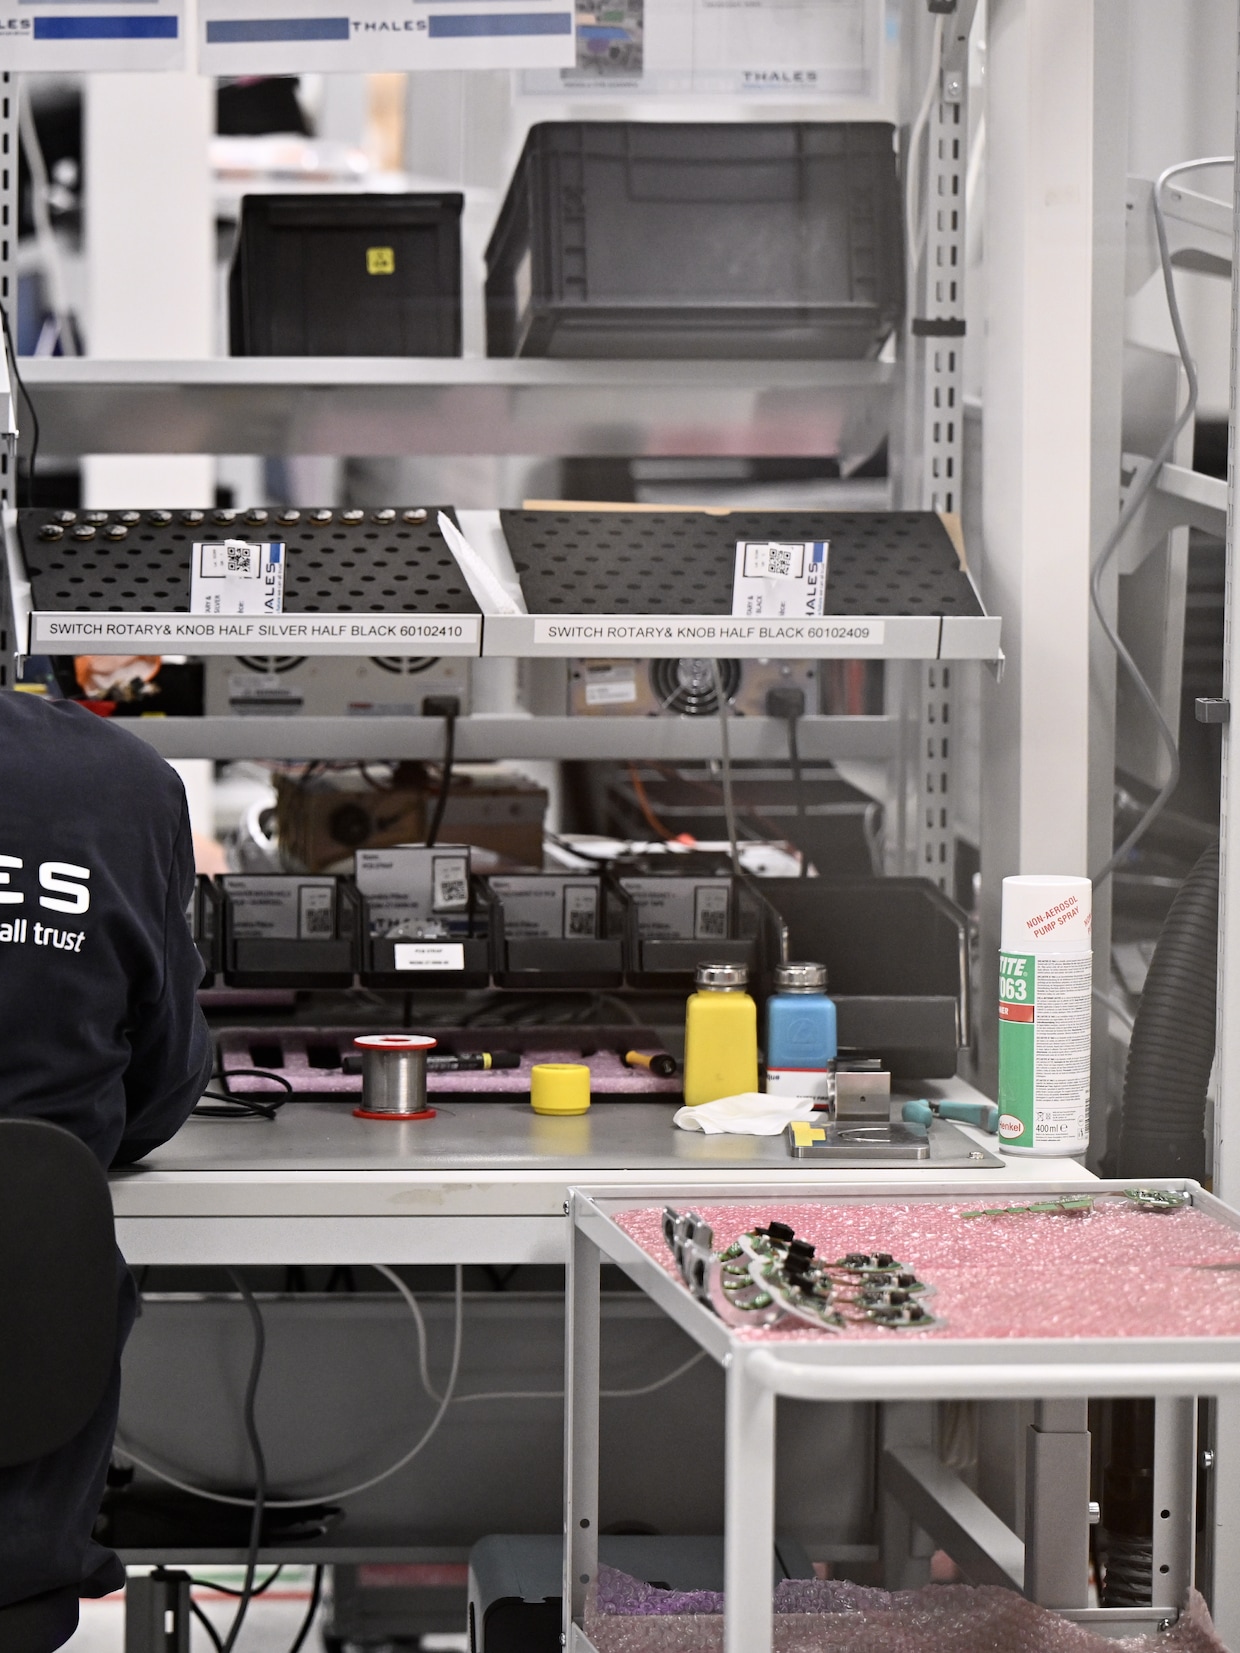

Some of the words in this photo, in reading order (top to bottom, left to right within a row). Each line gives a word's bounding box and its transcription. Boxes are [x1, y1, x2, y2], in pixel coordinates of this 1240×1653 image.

[352, 20, 426, 32] THALES
[742, 70, 818, 82] THALES
[50, 623, 102, 635] SWITCH
[106, 624, 172, 635] ROTARY&
[176, 625, 214, 635] KNOB
[219, 625, 254, 636] HALF
[258, 625, 307, 636] SILVER
[312, 626, 347, 636] HALF
[351, 626, 397, 636] BLACK
[400, 626, 463, 637] 60102410
[548, 627, 602, 638] SWITCH
[607, 627, 672, 638] ROTARY&
[677, 627, 716, 638] KNOB
[720, 627, 755, 638] HALF
[760, 627, 804, 638] BLACK
[808, 628, 870, 638] 60102409
[1026, 895, 1079, 929] NON-AEROSOL
[1033, 922, 1056, 938] PUMP
[1059, 906, 1080, 926] SPRAY
[33, 922, 86, 952] trust
